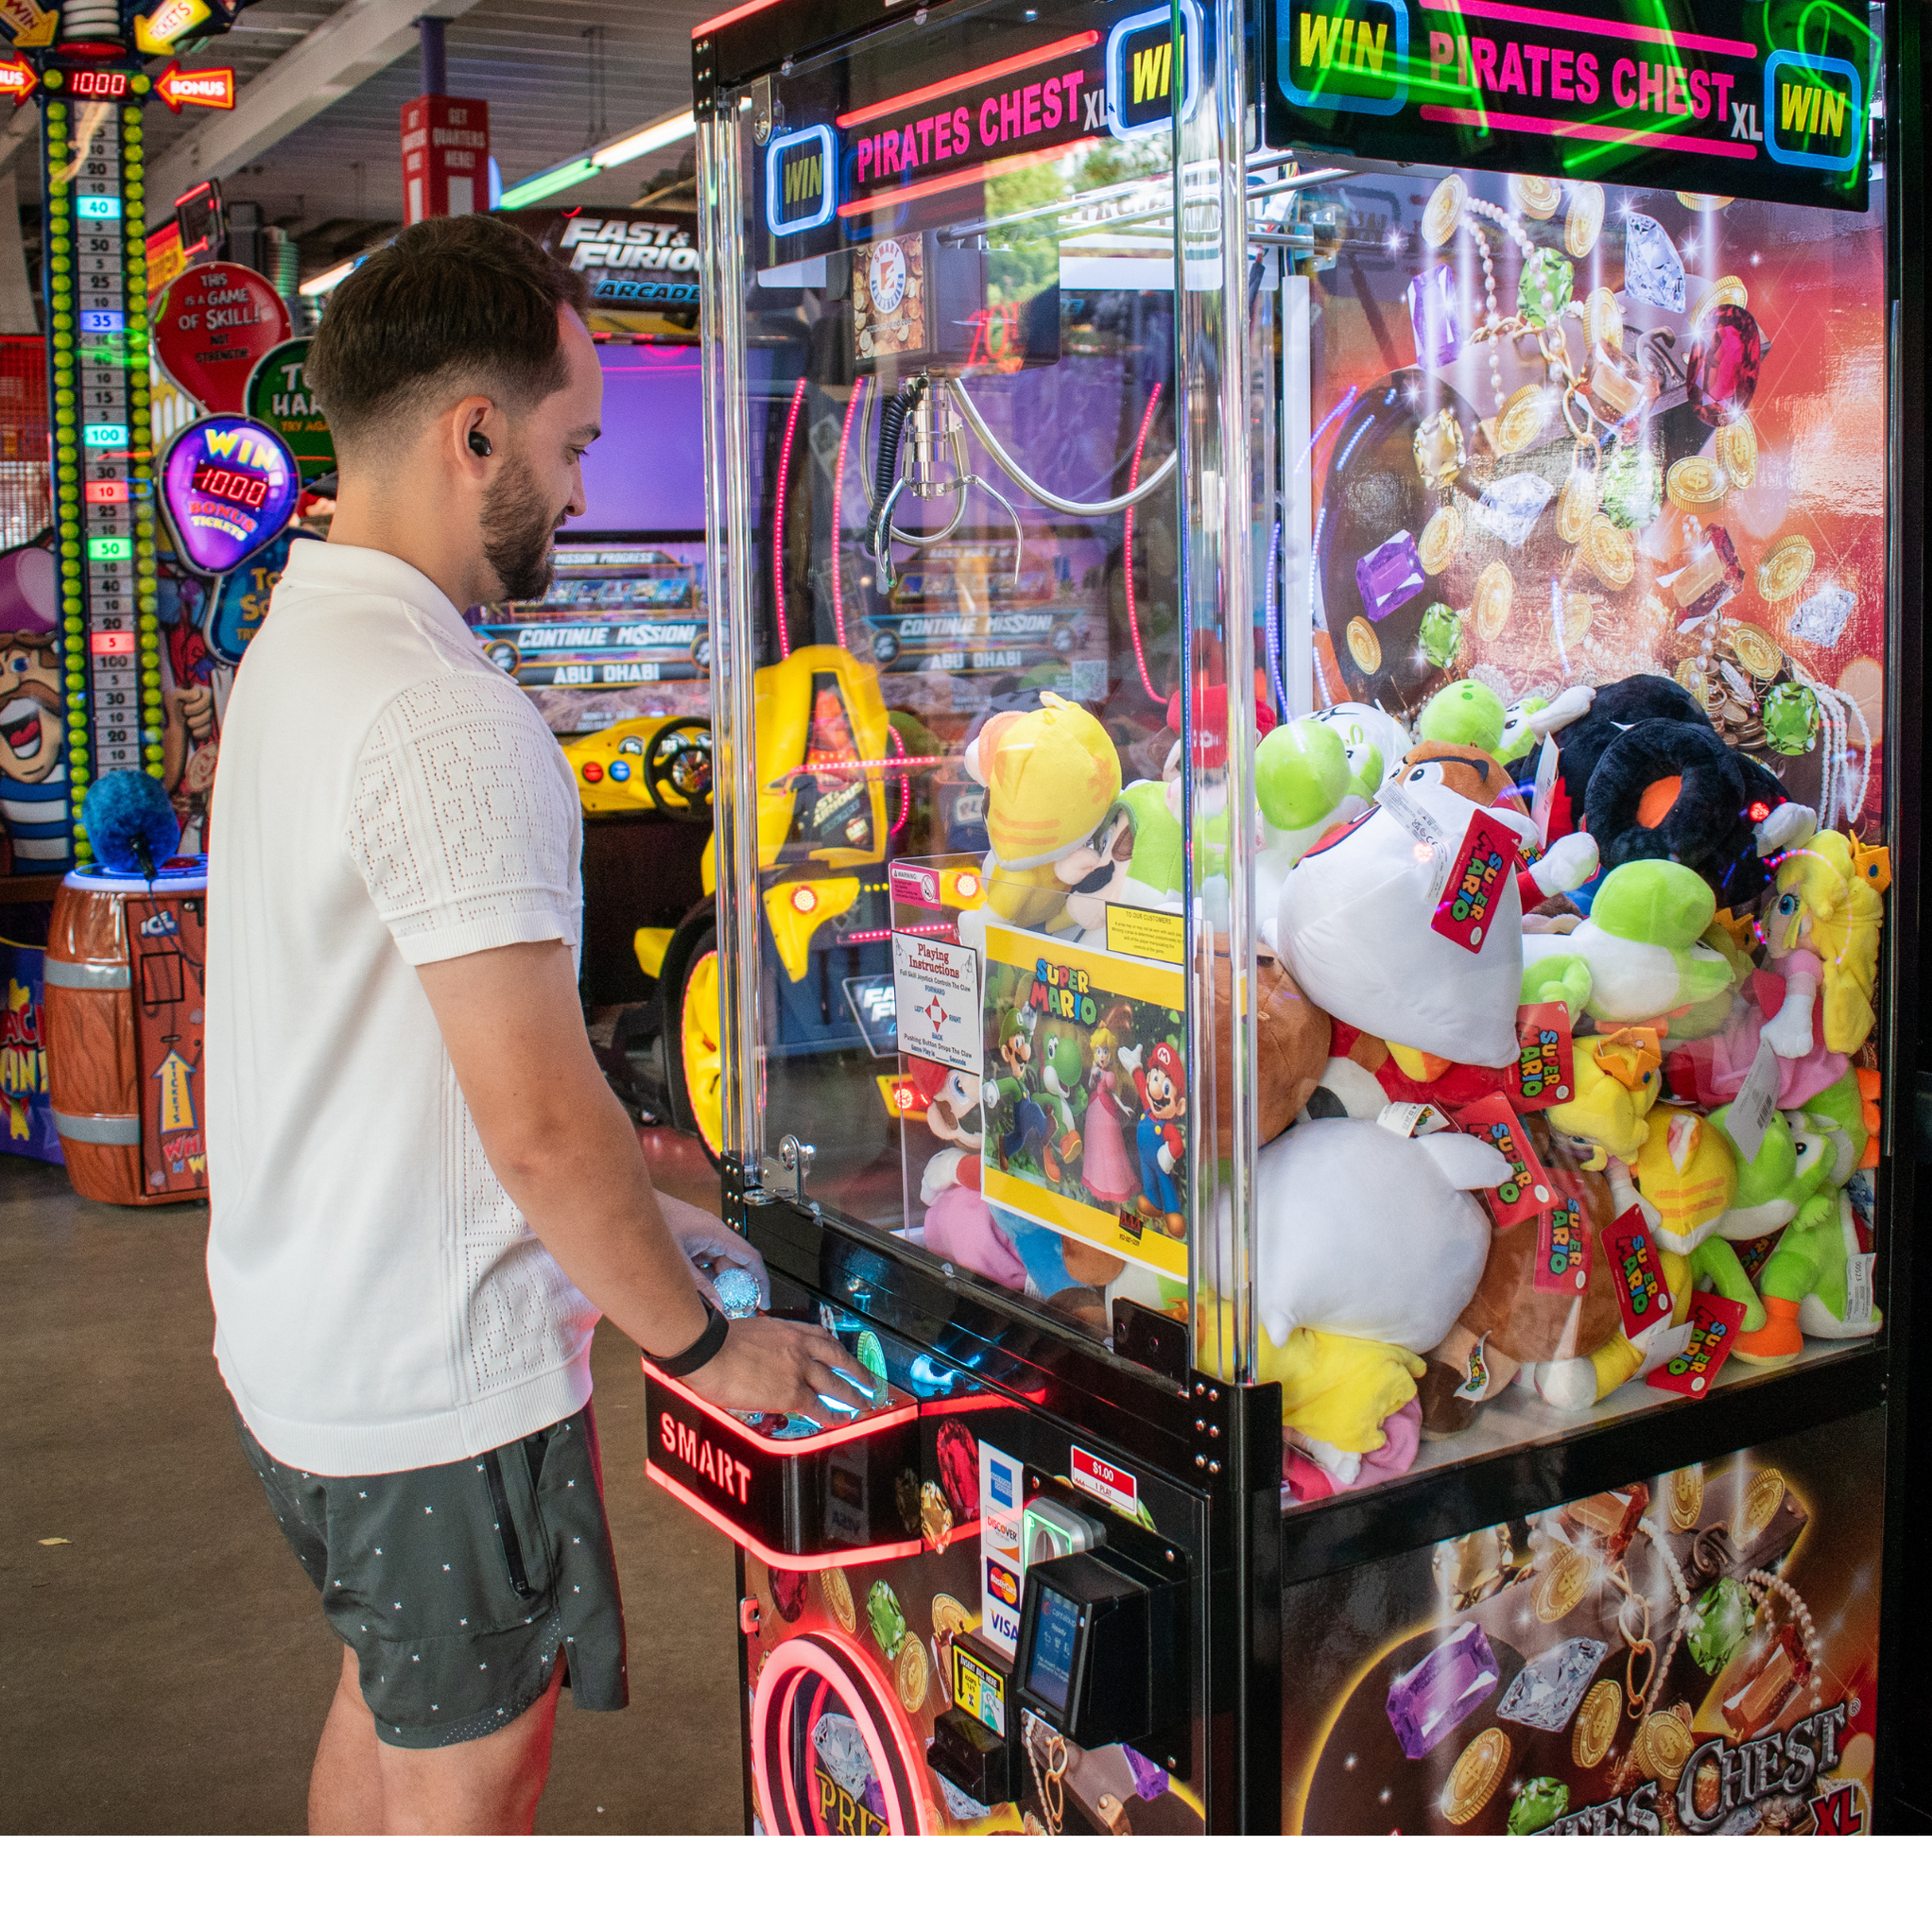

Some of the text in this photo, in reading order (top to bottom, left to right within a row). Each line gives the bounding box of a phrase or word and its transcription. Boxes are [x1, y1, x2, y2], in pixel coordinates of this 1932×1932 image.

[149, 2, 193, 42] TICKETS
[1300, 11, 1388, 76] WIN
[72, 73, 126, 95] 1000
[170, 80, 225, 96] BONUS
[1429, 30, 1763, 142] PIRATES CHEST XL
[1781, 83, 1846, 138] WIN
[857, 70, 1108, 184] PIRATES CHEST XL
[88, 164, 106, 175] 20
[784, 152, 823, 204] WIN
[91, 183, 104, 193] 10
[89, 202, 108, 214] 40
[95, 222, 103, 232] 5
[560, 217, 679, 248] FAST
[91, 239, 109, 250] 50
[874, 243, 900, 263] SMART
[95, 259, 104, 268] 5
[570, 242, 700, 272] FURIO
[91, 277, 109, 288] 25
[200, 273, 228, 287] THIS
[184, 288, 249, 306] IS A GAME
[595, 280, 700, 302] ARCADE
[94, 298, 108, 307] 10
[93, 316, 111, 327] 35
[178, 303, 261, 331] OF SKILL!
[96, 373, 111, 383] 10
[95, 391, 112, 404] 15
[101, 411, 109, 422] 5
[93, 429, 119, 441] 100
[205, 428, 282, 473] WIN
[97, 467, 115, 479] 30
[99, 487, 113, 497] 10
[201, 468, 267, 506] 1000
[98, 505, 116, 517] 25
[188, 501, 259, 532] BONUS
[102, 525, 116, 534] 10
[191, 515, 249, 542] TICKETS
[101, 543, 120, 555] 50
[103, 563, 118, 573] 10
[101, 580, 120, 592] 40
[105, 600, 119, 610] 10
[103, 617, 122, 630] 20
[900, 615, 1053, 635] CONTINUE MISSION!
[109, 638, 116, 648] 5
[518, 625, 697, 647] CONTINUE MISSION!
[100, 656, 128, 668] 100
[931, 650, 1022, 670] ABU DHABI
[111, 675, 119, 685] 5
[553, 663, 660, 684] ABU DHABI
[106, 693, 125, 705] 30
[110, 713, 124, 722] 10
[108, 730, 127, 742] 20
[112, 750, 126, 760] 10
[1451, 830, 1494, 922] MARIO
[1470, 853, 1503, 922] SUPER
[140, 910, 178, 938] ICE
[918, 943, 949, 965] Playing
[908, 955, 960, 979] Instructions
[1036, 958, 1089, 994] SUPER
[918, 973, 934, 983] Joystick
[934, 977, 952, 988] Controls
[952, 981, 960, 991] The
[960, 983, 971, 992] Claw
[924, 985, 945, 996] FORWARD
[914, 1005, 924, 1014] LEFT
[1029, 980, 1097, 1026] MARIO
[948, 1014, 961, 1024] RIGHT
[904, 1033, 972, 1059] Pushing Button Drops The Claw
[931, 1032, 943, 1042] BACK
[1516, 1021, 1543, 1097] MARIO
[1540, 1029, 1561, 1086] SUPER
[168, 1061, 181, 1124] TICKETS
[1492, 1122, 1533, 1188] SUPER
[1567, 1198, 1583, 1267] SUPER
[1616, 1236, 1649, 1316] MARIO
[1632, 1234, 1659, 1299] SUPER
[1690, 1321, 1728, 1373] SUPER
[660, 1411, 751, 1505] SMART
[1093, 1461, 1114, 1482] $1.00
[1099, 1484, 1112, 1496] PLAY
[987, 1515, 1018, 1543] DISCOVER
[991, 1574, 1017, 1596] MasterCard
[990, 1608, 1019, 1641] VISA
[960, 1653, 975, 1672] INSERT
[975, 1665, 985, 1680] BILL
[986, 1673, 997, 1688] HERE
[1810, 1785, 1864, 1835] XL
